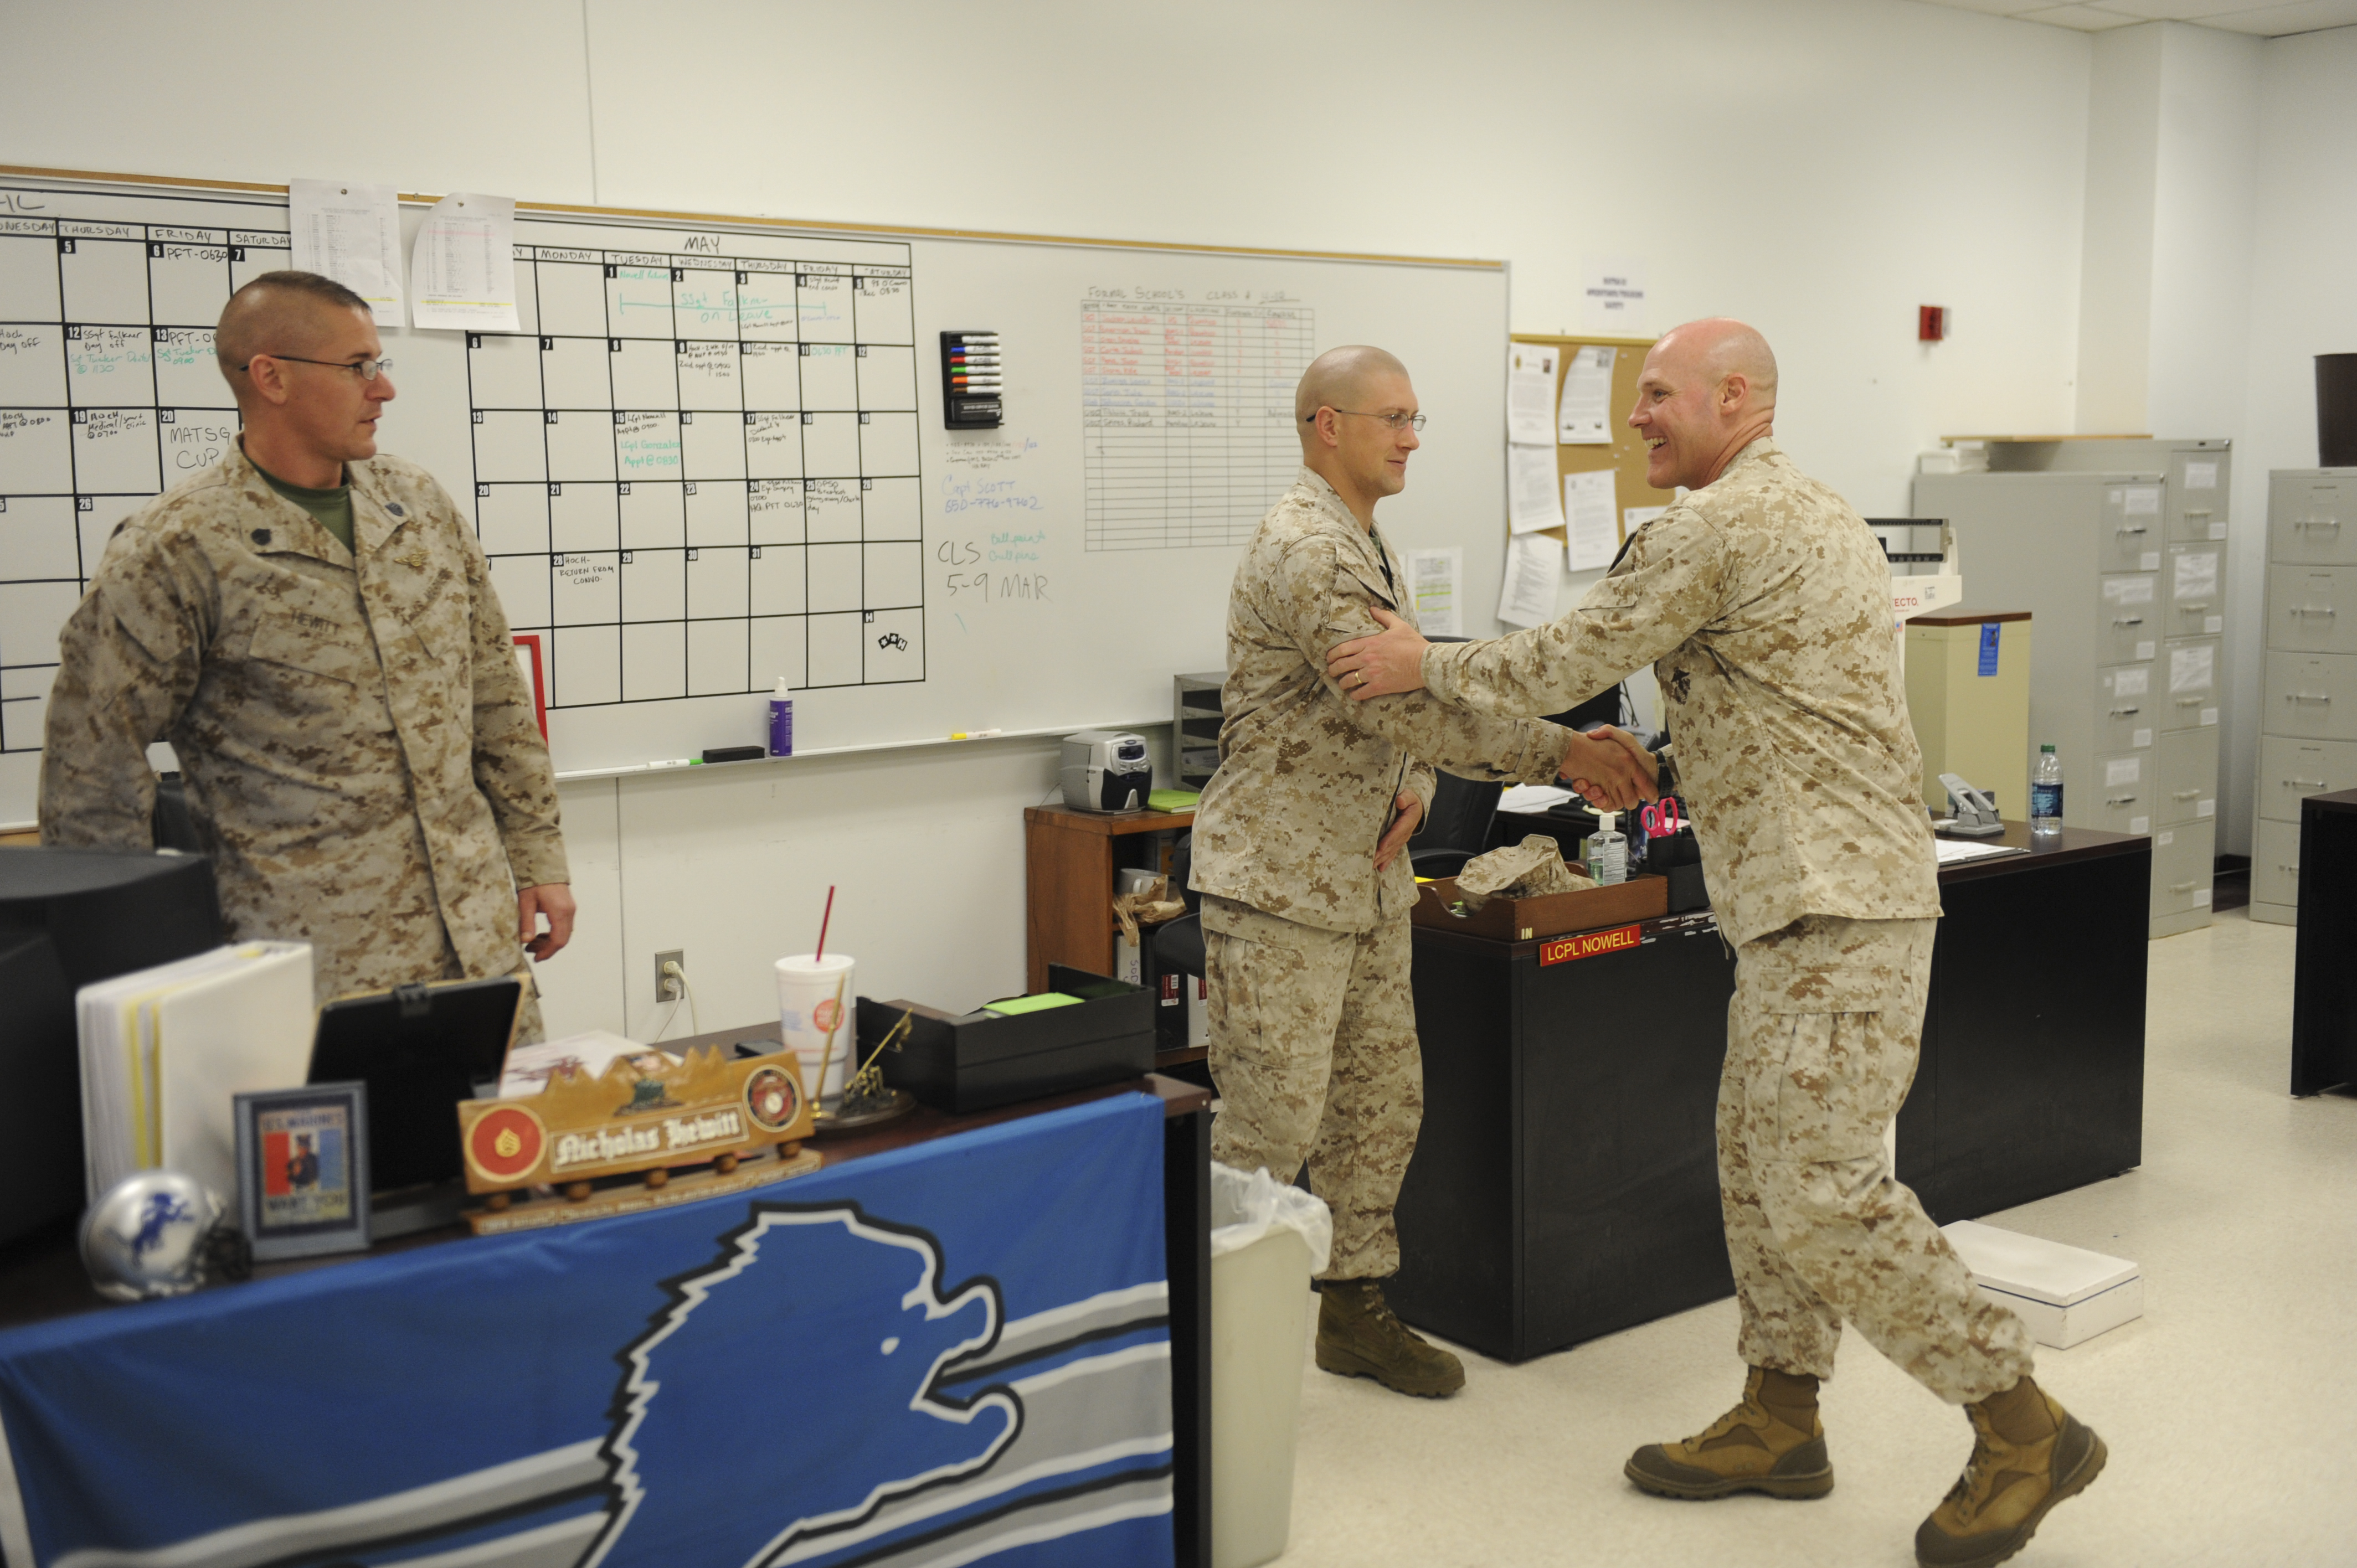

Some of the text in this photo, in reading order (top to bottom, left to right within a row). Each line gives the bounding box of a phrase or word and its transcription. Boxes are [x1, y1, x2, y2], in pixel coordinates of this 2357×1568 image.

[60, 224, 130, 238] THURSDAY
[155, 229, 212, 244] FRIDAY
[235, 234, 291, 246] SATURDAY
[683, 235, 721, 255] MAY
[64, 241, 72, 253] 5
[153, 245, 160, 257] 6
[234, 249, 241, 260] 7
[541, 249, 592, 261] MONDAY
[611, 253, 663, 266] TUESDAY
[678, 257, 733, 270] WEDNESDAY
[740, 260, 788, 271] THURSDAY
[609, 266, 614, 277] 1
[675, 270, 682, 281] 2
[802, 264, 838, 276] FRIDAY
[1088, 286, 1128, 300] FORMAL
[700, 309, 773, 323] on Leave
[67, 327, 81, 339] 12
[83, 328, 106, 341] SSgt
[155, 329, 167, 341] 13
[85, 342, 103, 354] Day
[472, 337, 478, 348] 6
[544, 339, 550, 350] 7
[613, 340, 619, 352] 8
[679, 342, 685, 353] 9
[742, 343, 752, 354] 10
[801, 344, 810, 355] 11
[858, 347, 867, 357] 12
[93, 364, 115, 374] 1130
[74, 411, 86, 422] 19
[161, 410, 173, 422] 20
[472, 411, 483, 423] 13
[547, 412, 558, 423] 14
[615, 413, 625, 424] 15
[682, 413, 692, 424] 16
[746, 413, 755, 424] 17
[802, 413, 812, 424] 18
[860, 413, 869, 424] 19
[169, 426, 231, 446] MATSG
[176, 447, 220, 470] CUP
[478, 484, 490, 496] 20
[550, 484, 560, 495] 21
[620, 483, 630, 494] 22
[686, 483, 696, 494] 23
[750, 481, 759, 492] 24
[806, 480, 815, 491] 25
[862, 479, 872, 490] 26
[79, 498, 91, 510] 26
[621, 552, 632, 563] 29
[687, 549, 697, 560] 30
[752, 548, 761, 558] 31
[938, 540, 981, 565] CLS
[553, 555, 564, 565] 28
[559, 566, 615, 577] RETURN FROM
[946, 572, 1053, 603] 5-9 MAR
[1520, 927, 1533, 941] IN
[1547, 930, 1635, 961] LCPL NOWELL
[554, 1122, 660, 1166] Nicholas
